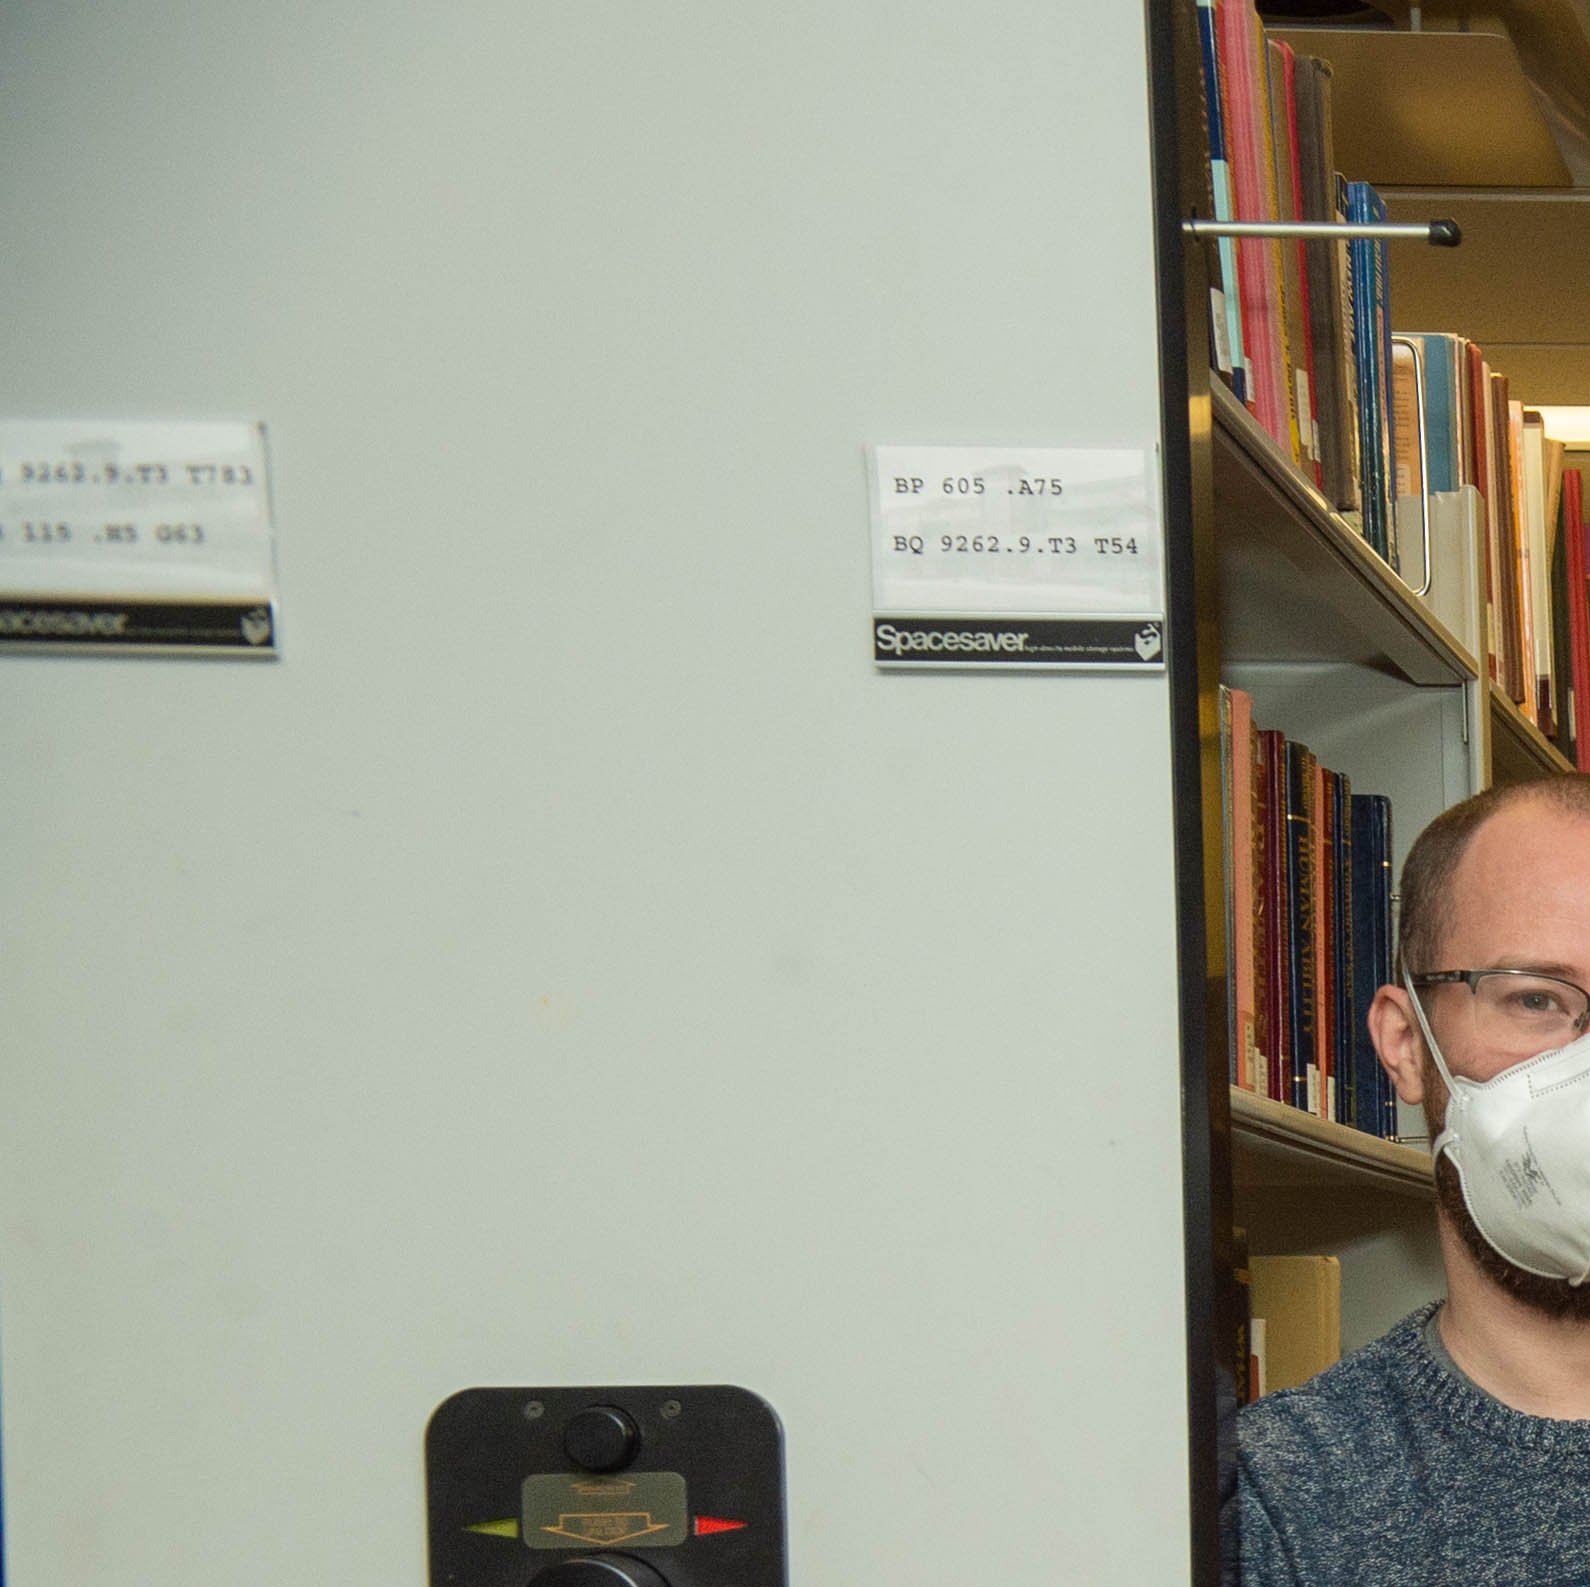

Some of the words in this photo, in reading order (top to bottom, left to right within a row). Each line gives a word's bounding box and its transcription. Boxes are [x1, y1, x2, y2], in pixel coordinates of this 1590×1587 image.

[894, 477, 925, 494] BP
[942, 477, 986, 494] 605
[1006, 478, 1063, 496] .A75
[893, 535, 925, 555] BQ
[941, 535, 1078, 554] 9262.9.T3
[1094, 537, 1139, 554] T54
[876, 623, 1029, 656] Spacesaver
